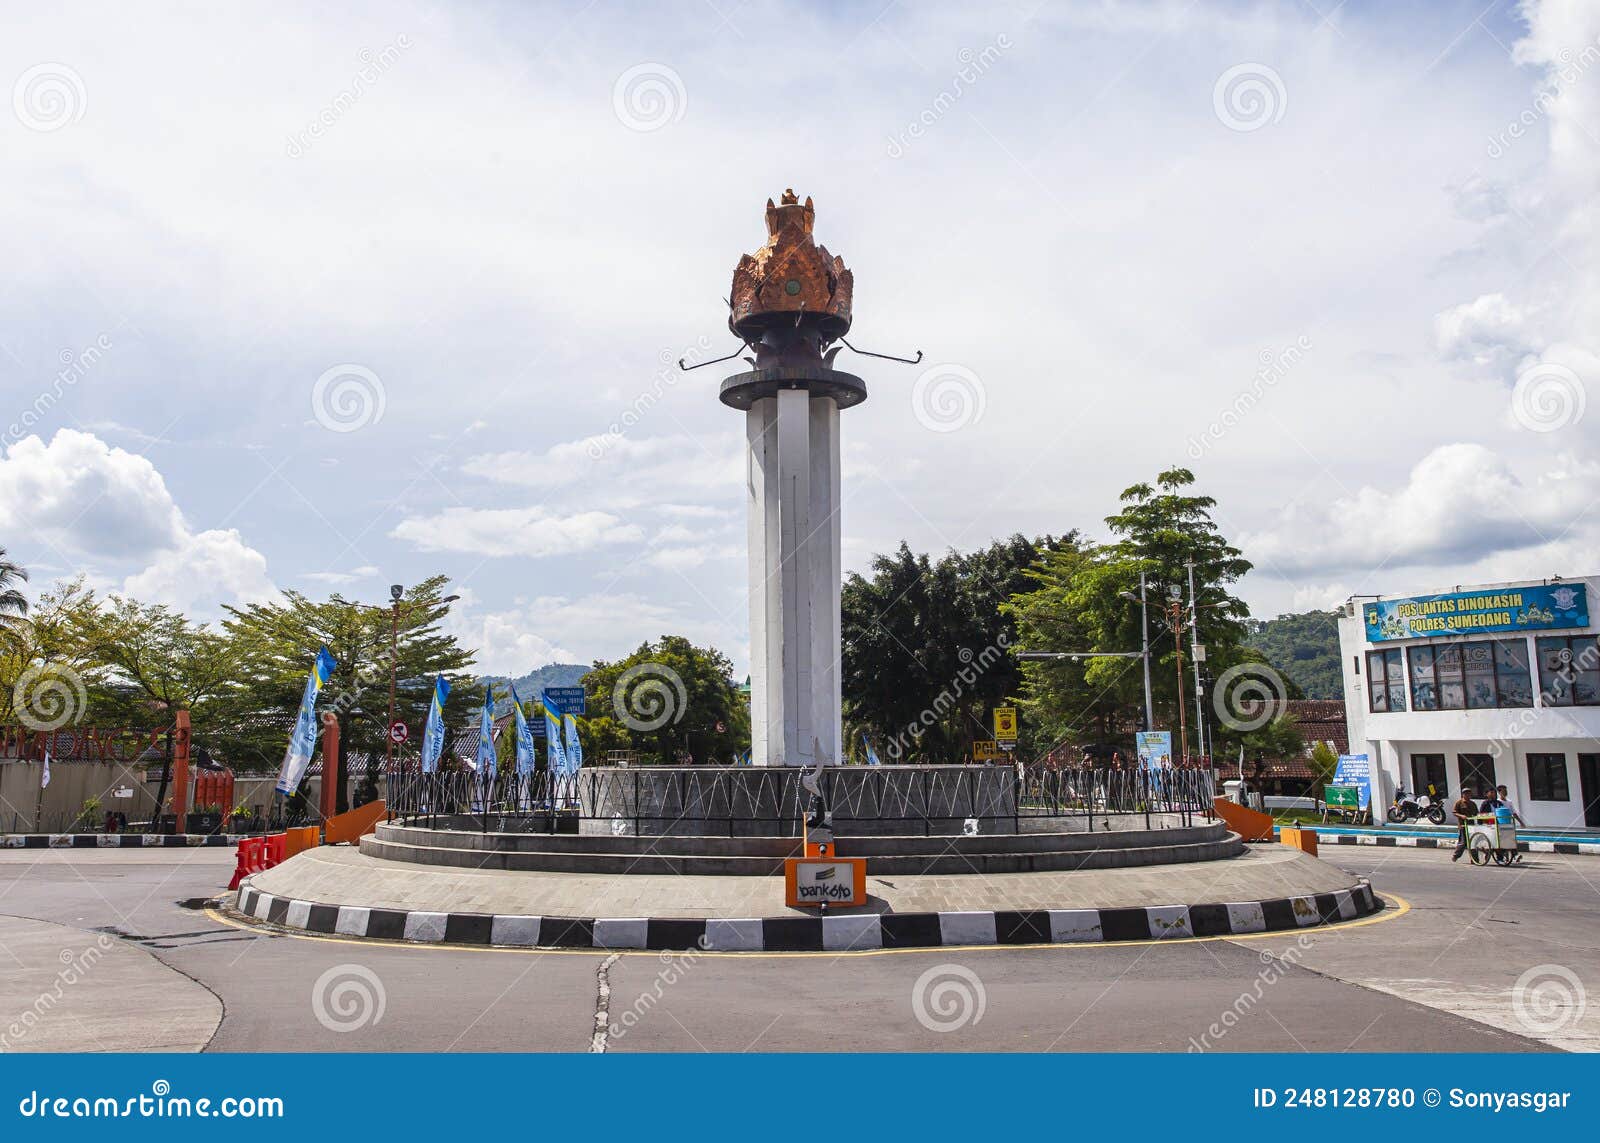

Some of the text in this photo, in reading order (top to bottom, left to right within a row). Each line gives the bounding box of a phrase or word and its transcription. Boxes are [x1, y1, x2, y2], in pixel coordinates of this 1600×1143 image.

[1398, 593, 1523, 617] POS LANTAS BINOKASIH
[1409, 612, 1511, 632] POLRES SUMEDANG
